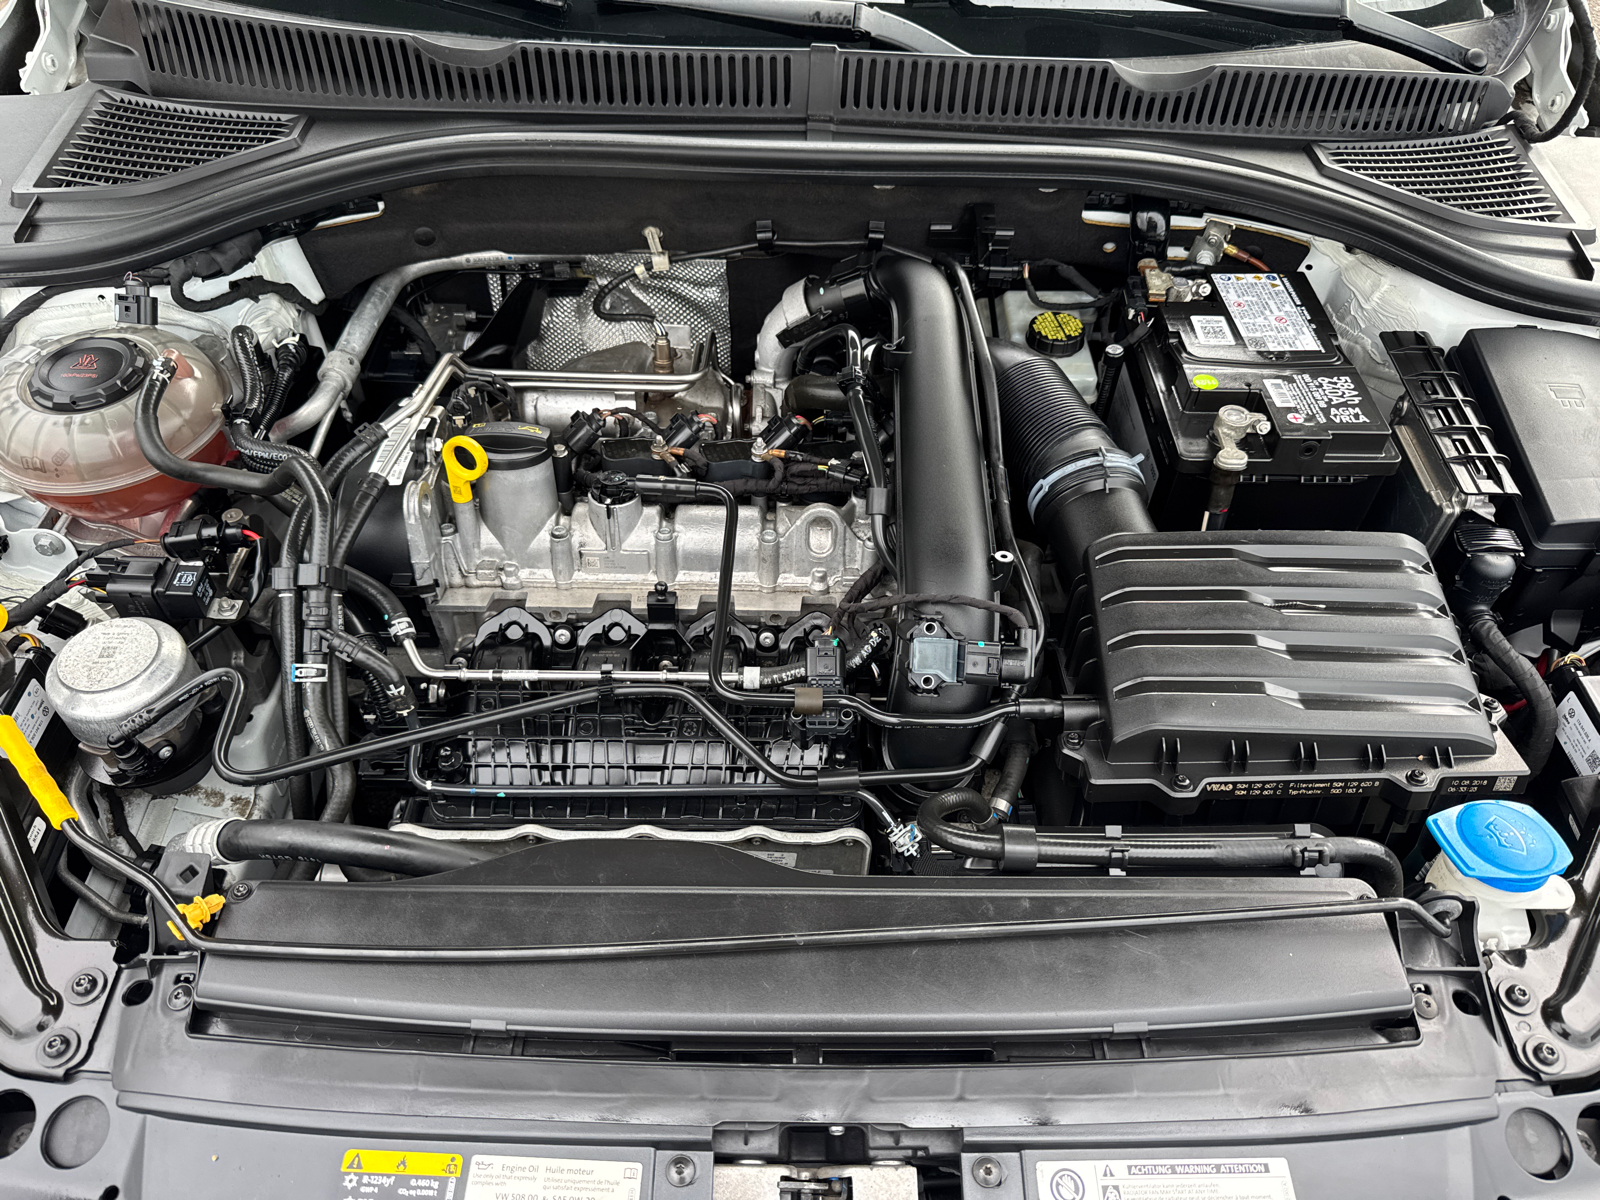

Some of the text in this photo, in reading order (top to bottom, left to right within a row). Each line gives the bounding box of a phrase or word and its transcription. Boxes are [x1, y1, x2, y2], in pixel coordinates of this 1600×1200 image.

[1318, 376, 1346, 404] 640A
[1337, 376, 1362, 404] 58Ah
[1330, 407, 1362, 415] AGM
[1330, 415, 1370, 423] VRLA
[502, 1164, 539, 1174] Engine Oil
[545, 1166, 565, 1175] Huile
[1130, 1164, 1265, 1175] ACHTUNG WARNING ATTENTION
[362, 1175, 395, 1187] R-1234yf
[431, 1179, 439, 1189] kg
